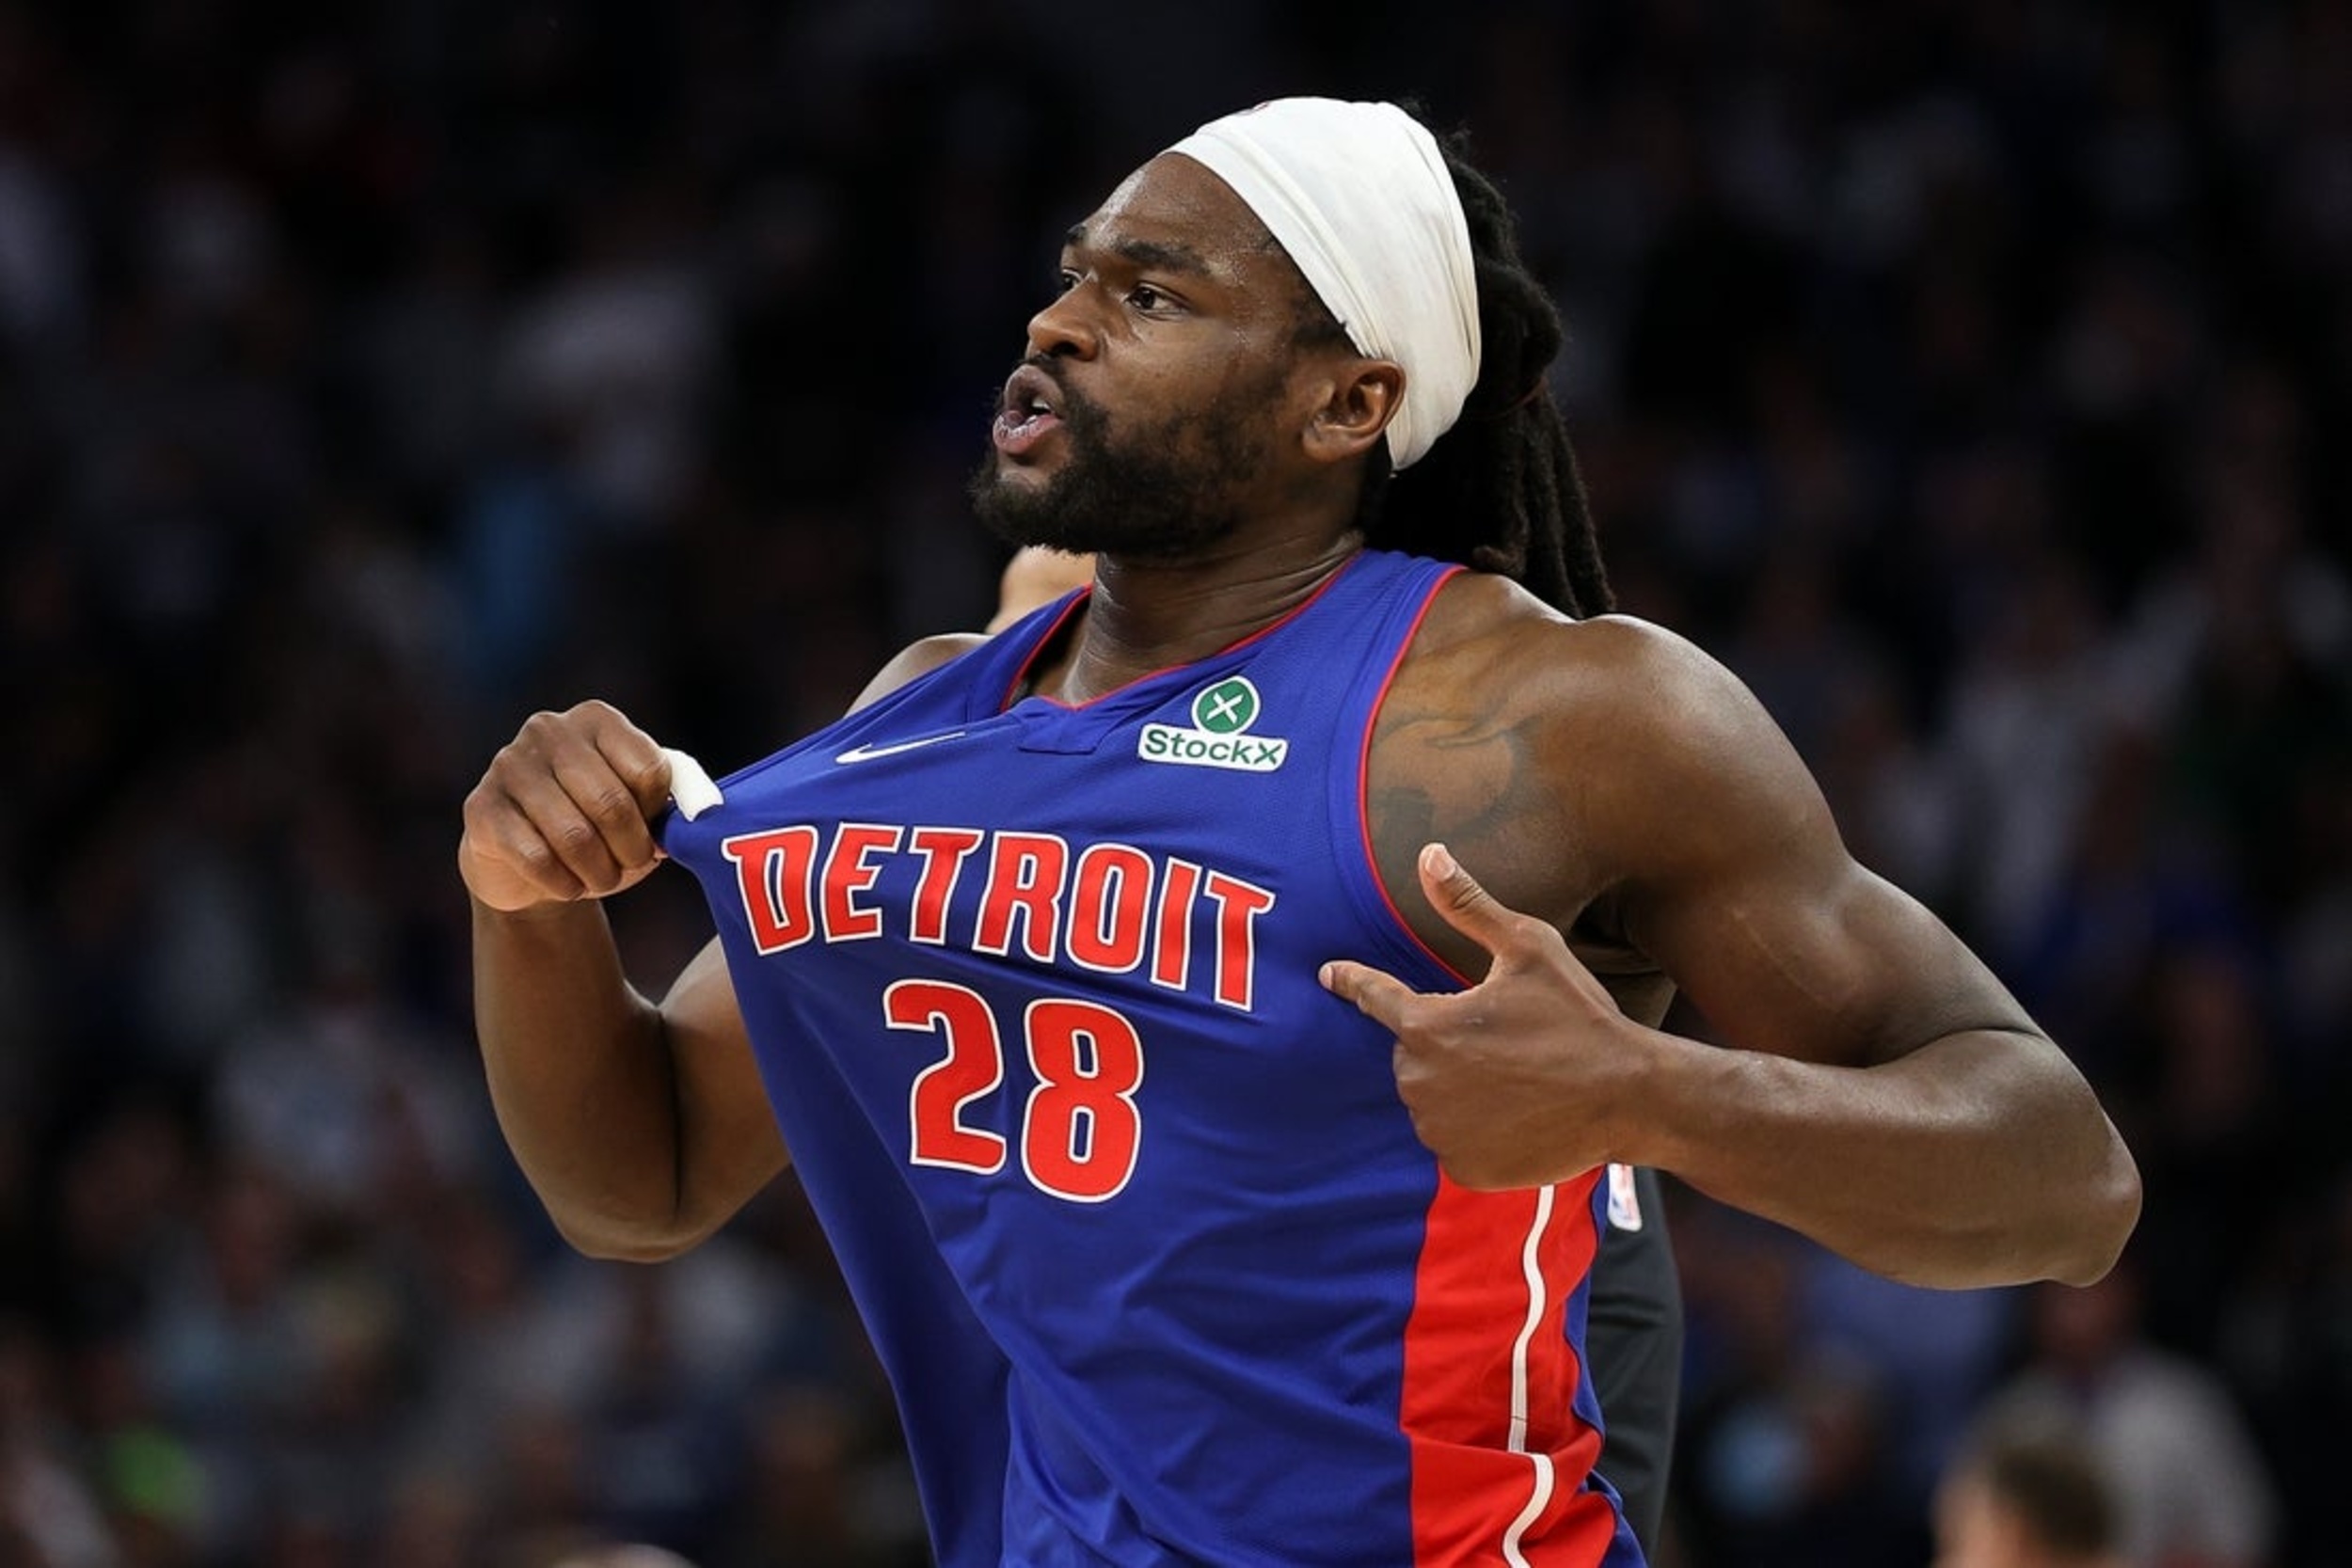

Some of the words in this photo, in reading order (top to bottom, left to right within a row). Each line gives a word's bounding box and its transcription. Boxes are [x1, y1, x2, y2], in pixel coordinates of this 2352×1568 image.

[1145, 729, 1282, 765] StockX
[723, 822, 1275, 1012] DETROIT
[883, 979, 1143, 1202] 28
